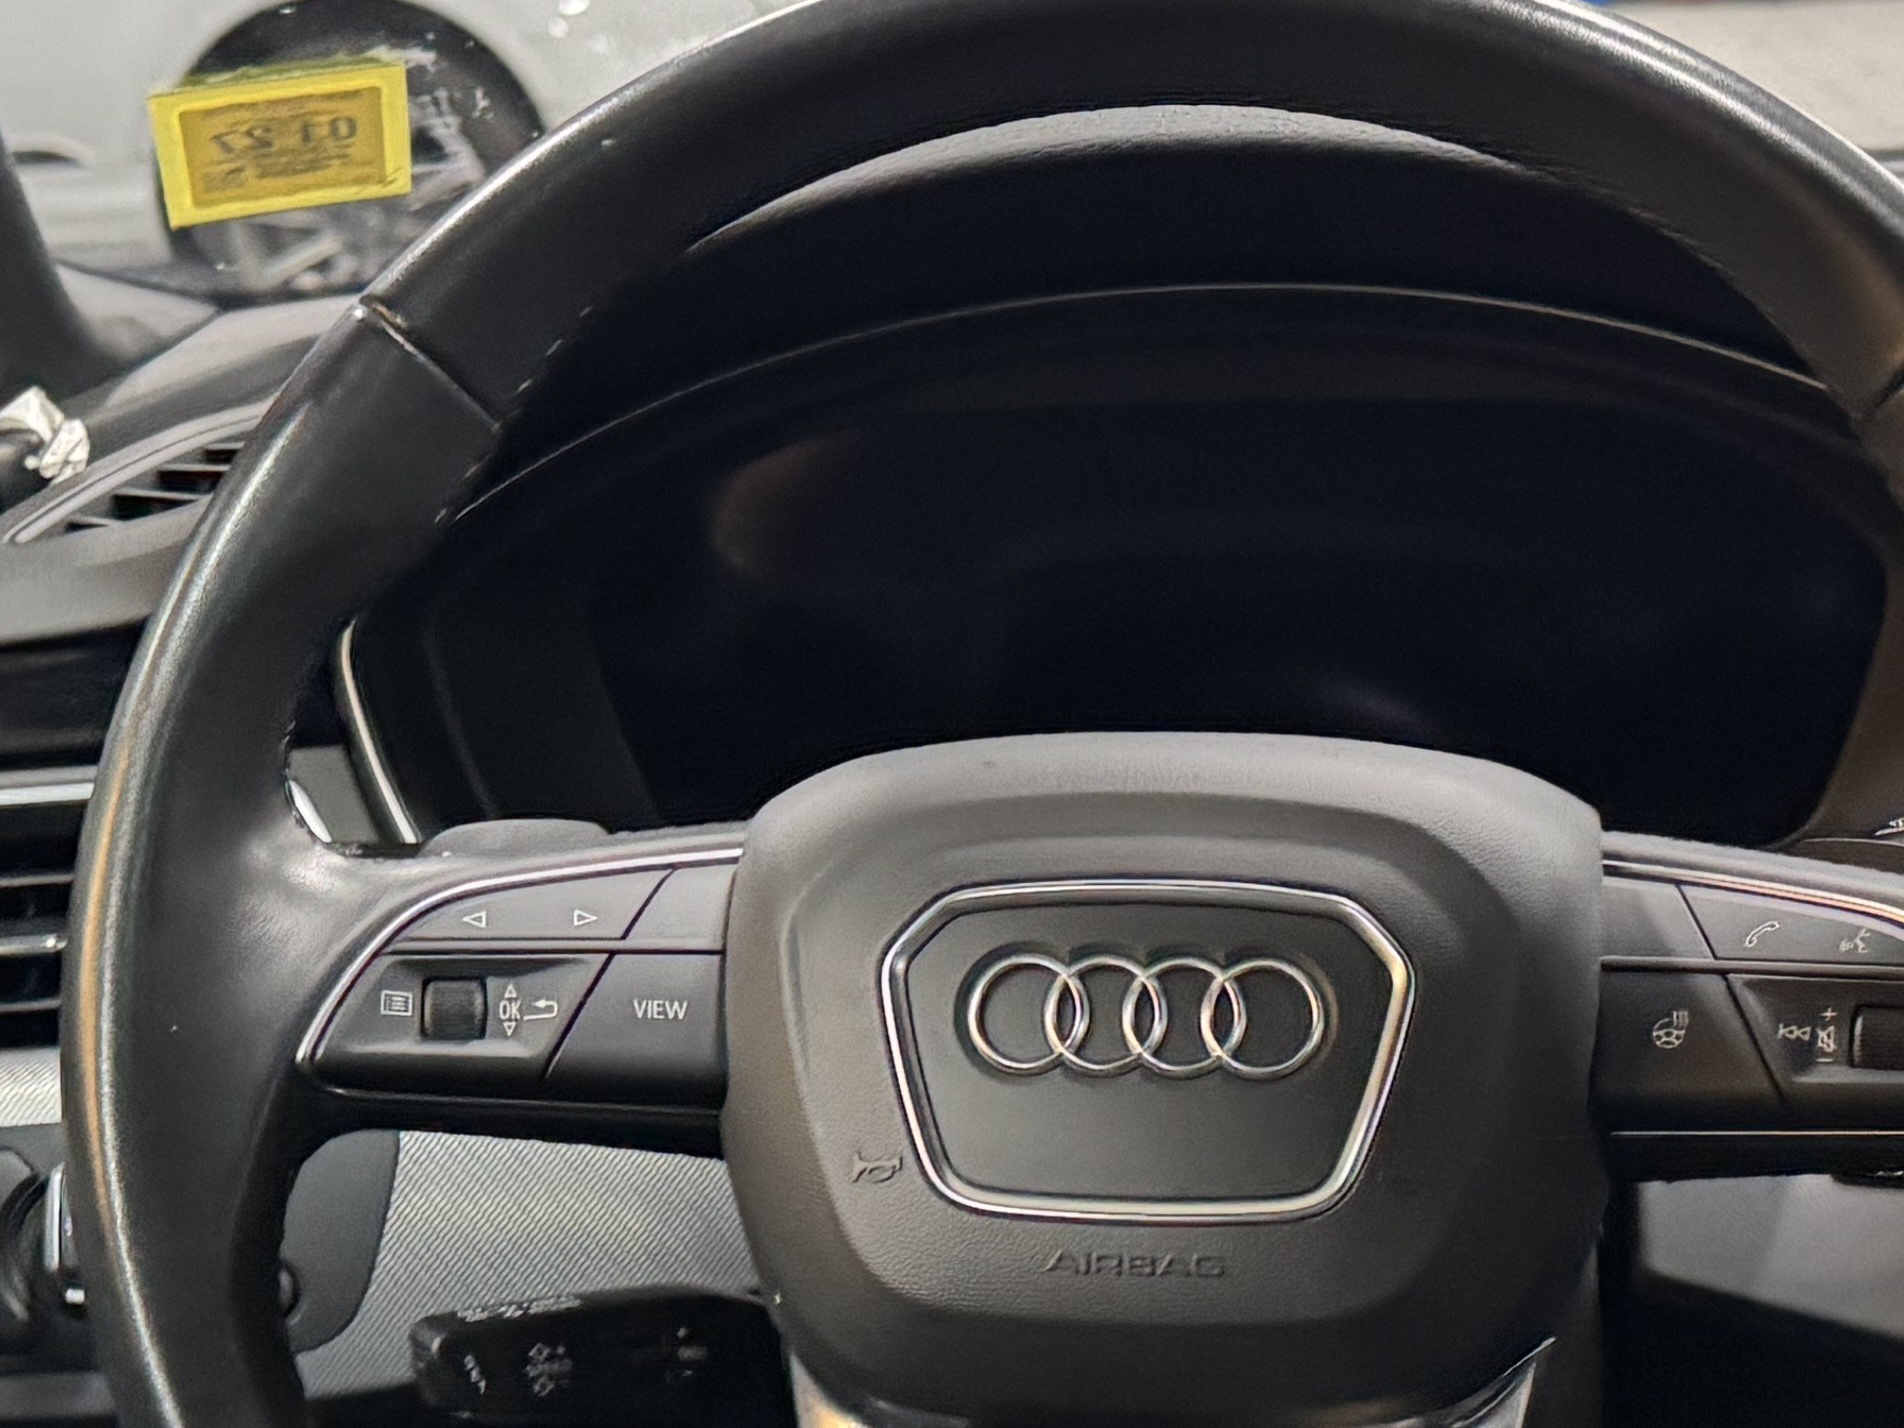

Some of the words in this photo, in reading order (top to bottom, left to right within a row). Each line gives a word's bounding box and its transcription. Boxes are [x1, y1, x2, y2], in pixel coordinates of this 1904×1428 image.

[499, 999, 522, 1020] OK
[633, 998, 688, 1021] VIEW
[1040, 1248, 1227, 1278] AIRBAG
